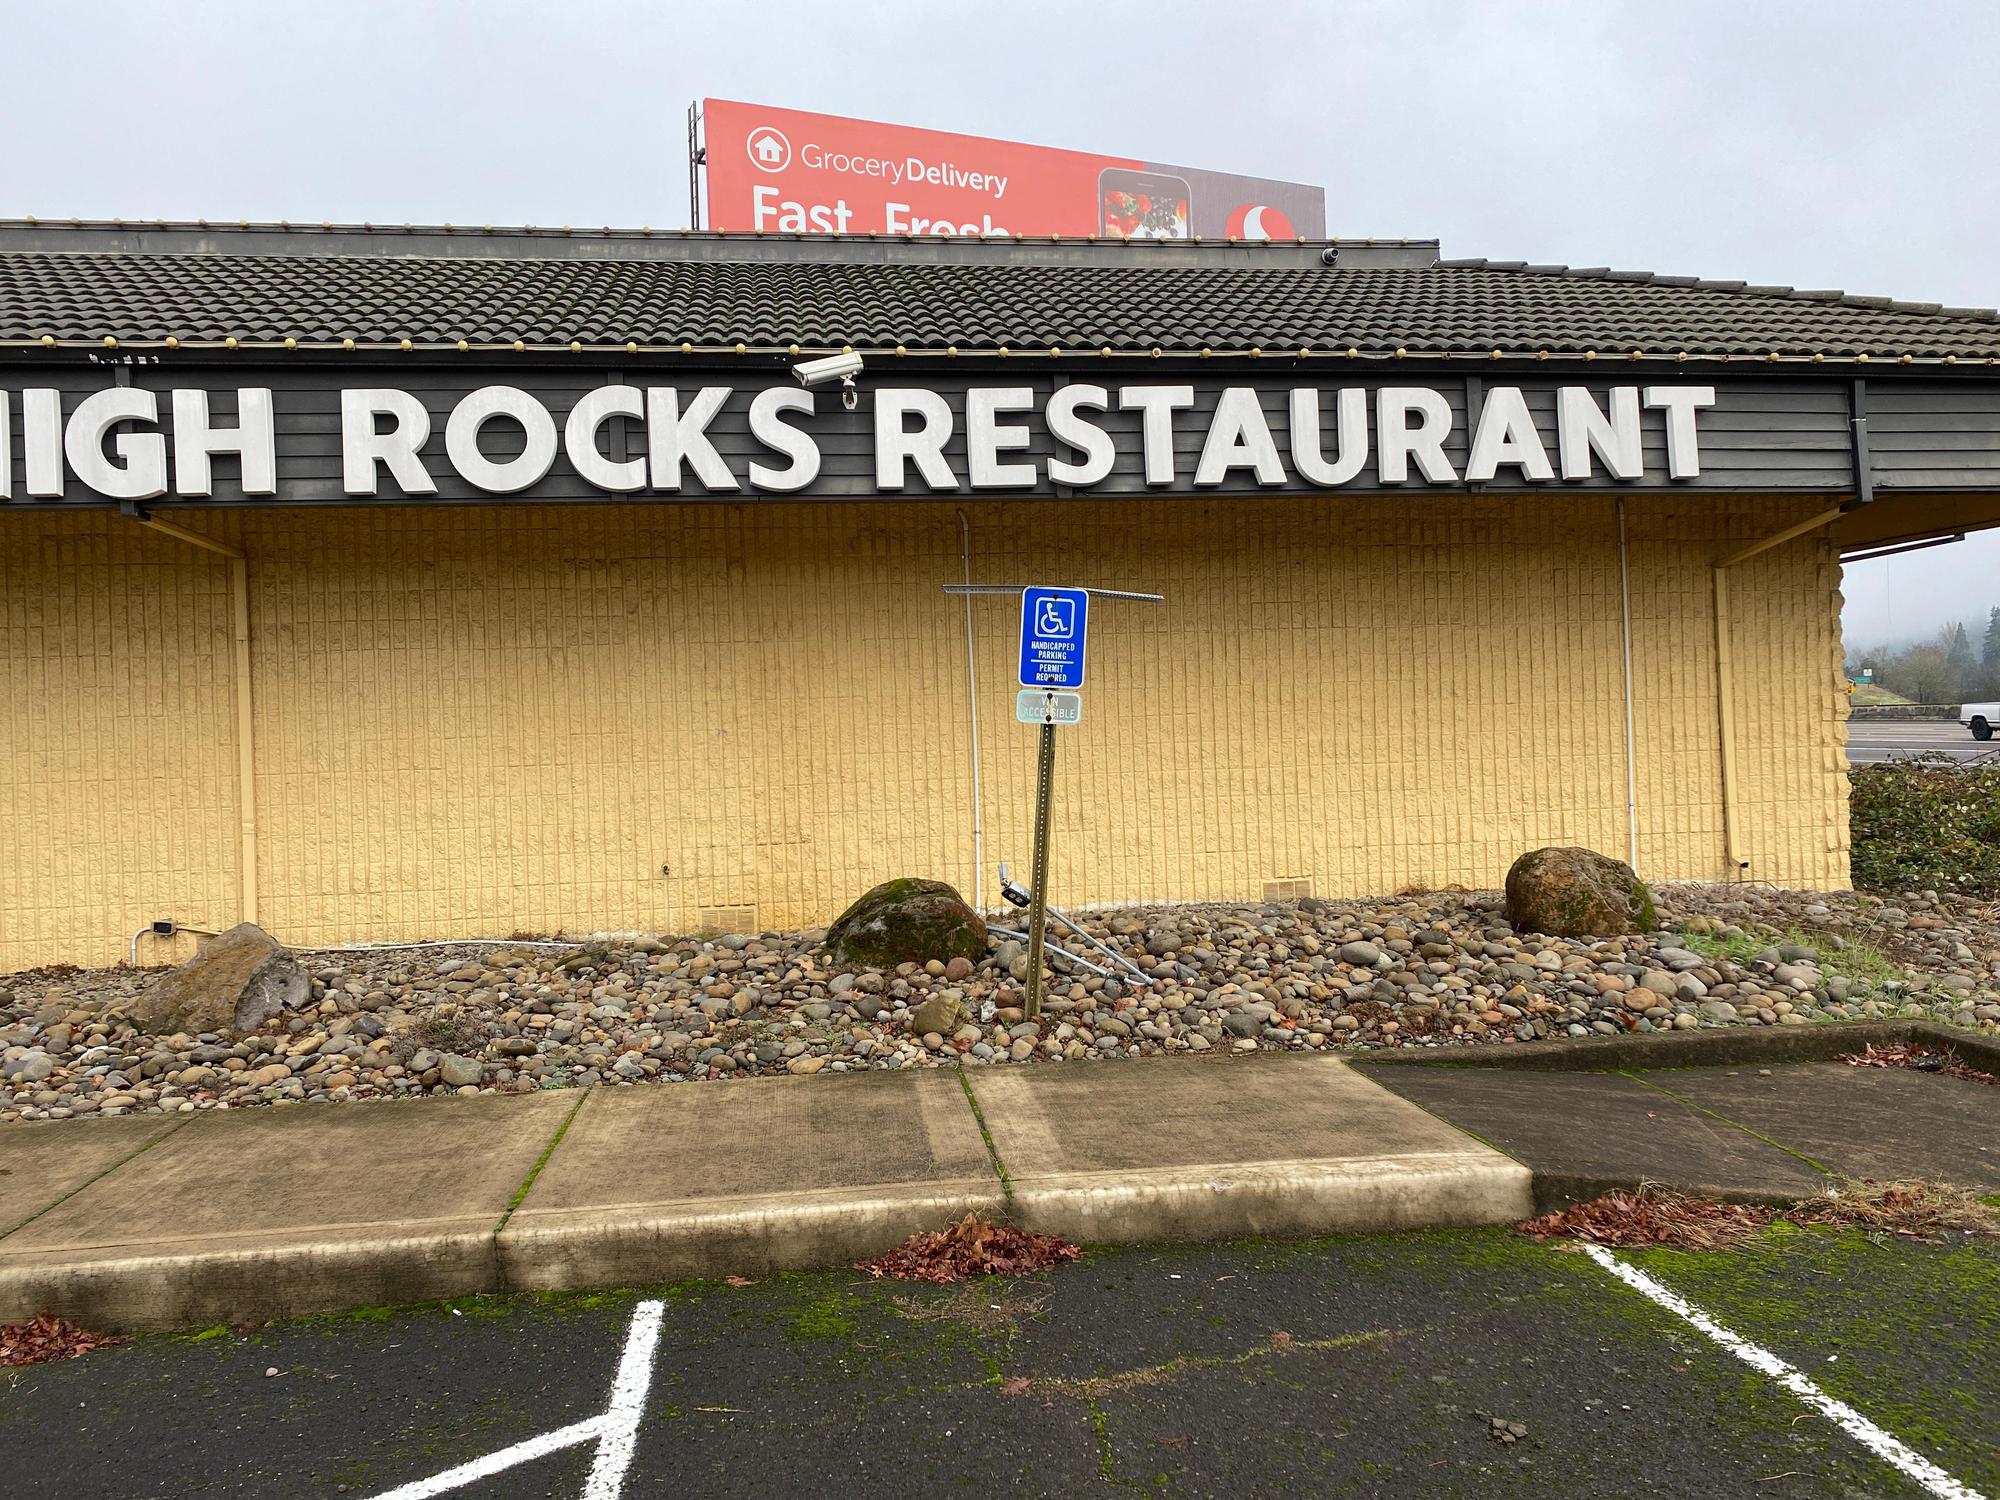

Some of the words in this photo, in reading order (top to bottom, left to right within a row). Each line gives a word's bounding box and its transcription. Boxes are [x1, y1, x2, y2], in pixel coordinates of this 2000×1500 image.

[801, 143, 1008, 199] GroceryDelivery
[753, 185, 853, 233] Fast
[0, 386, 277, 499] IGH
[340, 384, 821, 496] ROCKS
[873, 383, 1717, 489] RESTAURANT
[1031, 641, 1075, 651] HANDICAPPED
[1038, 650, 1067, 660] PARKING
[1039, 664, 1064, 673] PERMIT
[1023, 707, 1075, 718] ACCESSIBLE
